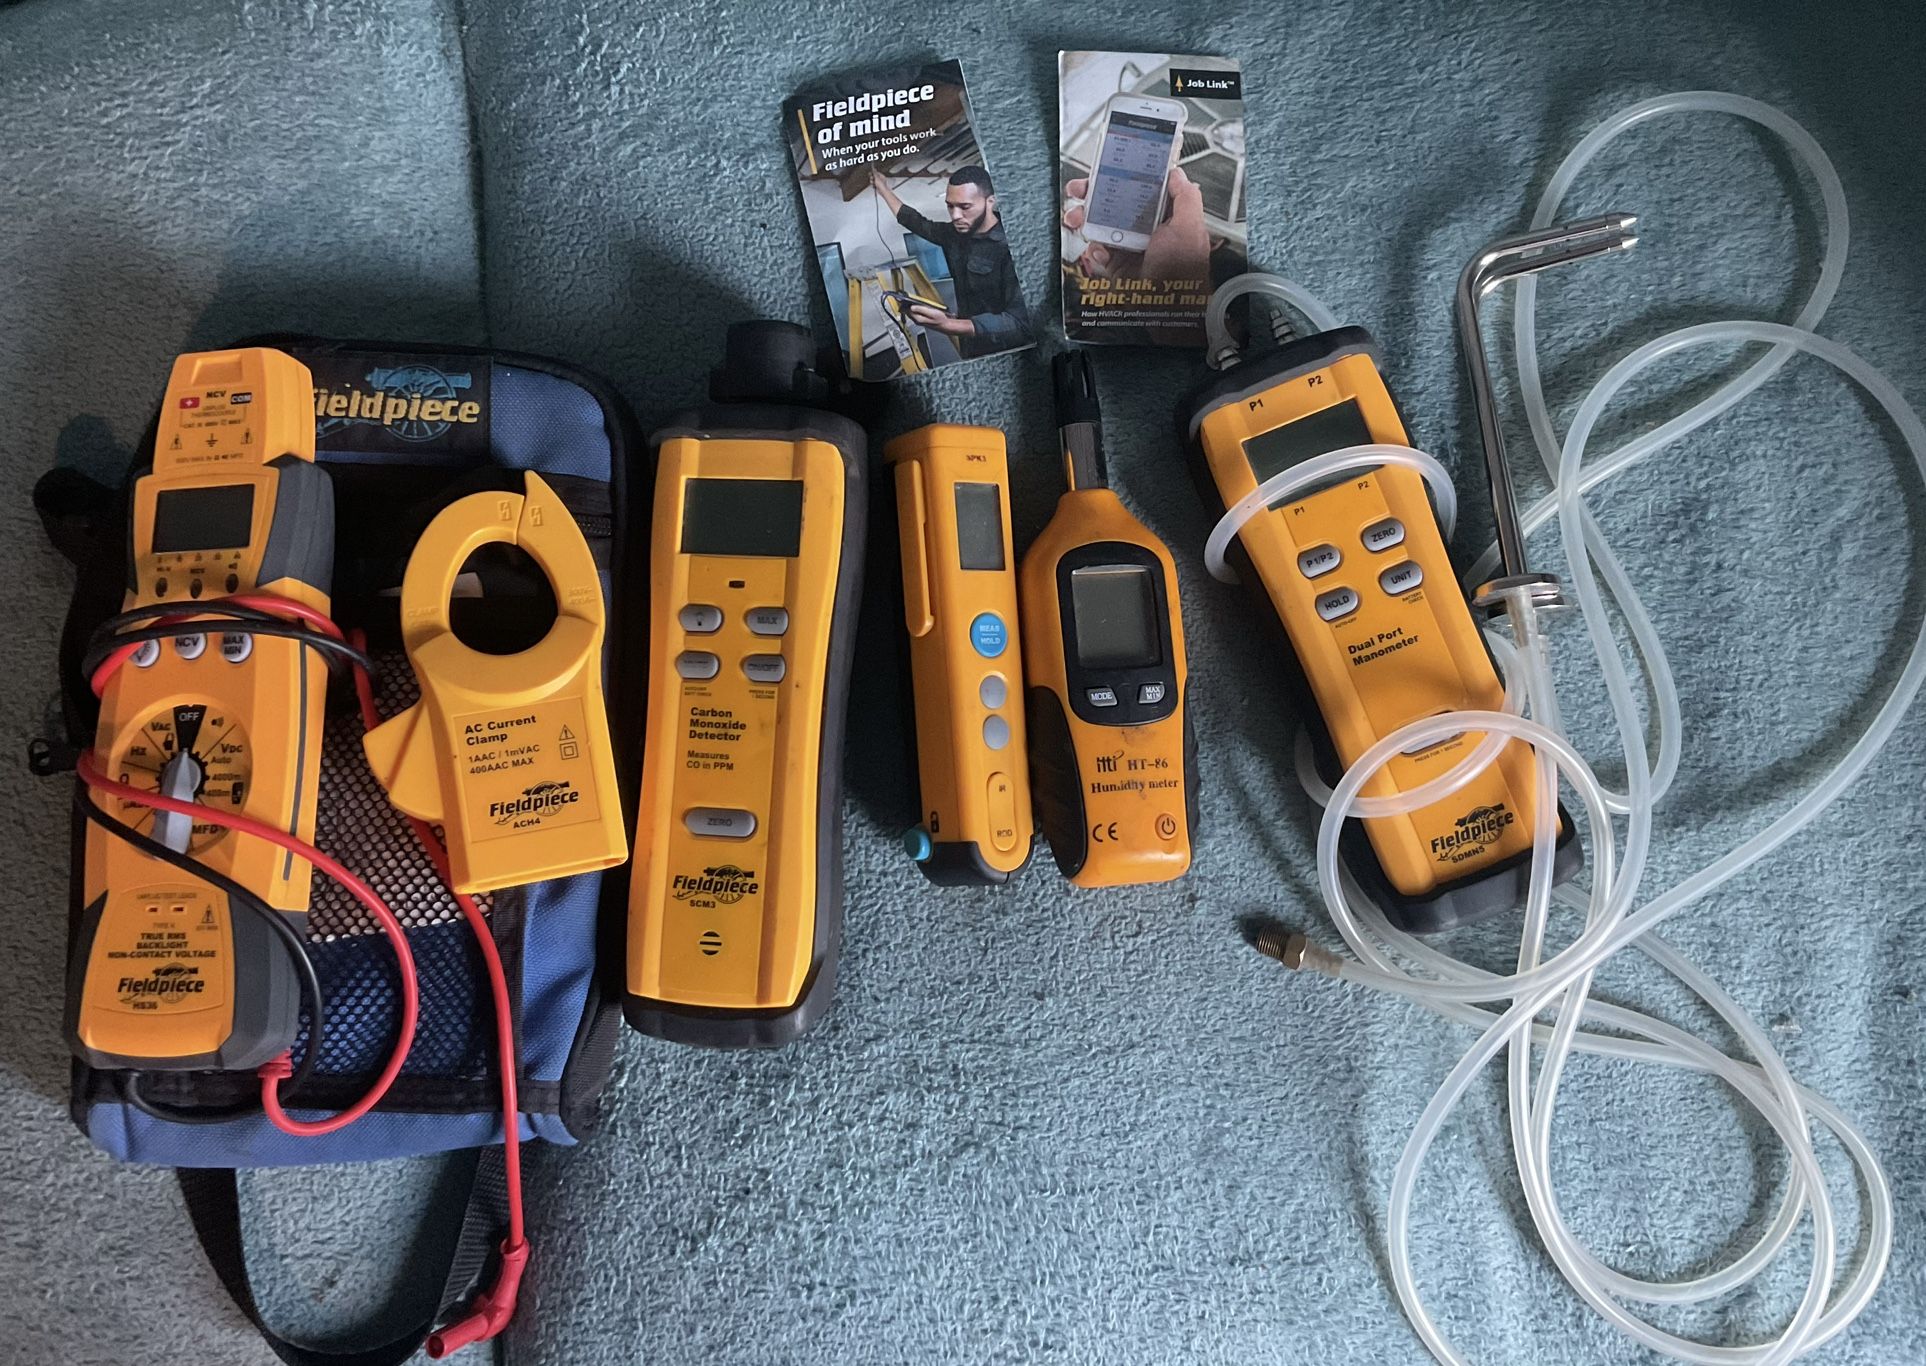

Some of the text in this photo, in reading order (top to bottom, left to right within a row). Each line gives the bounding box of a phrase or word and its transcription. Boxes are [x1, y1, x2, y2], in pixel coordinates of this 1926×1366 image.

[1187, 79, 1205, 88] Job
[812, 84, 934, 122] Fieldpiece
[818, 109, 911, 144] of mind
[822, 127, 937, 159] When your tools work
[825, 144, 920, 171] as hard as you do.
[1080, 278, 1203, 292] Job Link, your
[1080, 292, 1177, 308] right-hand
[1123, 311, 1169, 319] professionals
[1307, 375, 1323, 388] P2
[206, 390, 227, 399] NCV
[313, 388, 481, 425] ieldpiece
[1249, 398, 1264, 411] P1
[1357, 480, 1369, 490] P2
[1294, 506, 1305, 516] P1
[1371, 527, 1396, 543] ZERO
[1306, 552, 1335, 568] P1/P2
[1390, 570, 1412, 585] UNIT
[1324, 595, 1350, 611] HOLD
[175, 636, 200, 647] NCV
[1347, 627, 1403, 655] Dual Port
[1352, 635, 1419, 666] Manometer
[1091, 691, 1113, 701] MODE
[1145, 686, 1161, 694] MAX
[178, 712, 200, 722] OFF
[690, 707, 733, 718] Carbon
[465, 715, 537, 734] AC Current
[689, 718, 747, 731] Monoxide
[466, 733, 508, 746] Clamp
[688, 730, 742, 741] Detector
[469, 752, 496, 763] 1AAC
[505, 744, 540, 757] 1mVAC
[687, 750, 730, 760] Measures
[470, 757, 535, 774] 400AAC MAX
[686, 760, 734, 771] CO in PPM
[1127, 758, 1169, 771] HT-86
[1149, 779, 1179, 789] meter
[489, 790, 579, 817] Fieldpiece
[513, 818, 541, 829] ACH4
[707, 817, 733, 827] ZERO
[1431, 811, 1514, 853] Fieldpiece
[673, 875, 759, 895] Fieldpiece
[140, 932, 187, 940] TRUE RMS
[136, 941, 189, 950] BACKLIGHT
[107, 950, 217, 959] NON-CONTACT VOLTAGE
[117, 977, 205, 996] Fieldpiece
